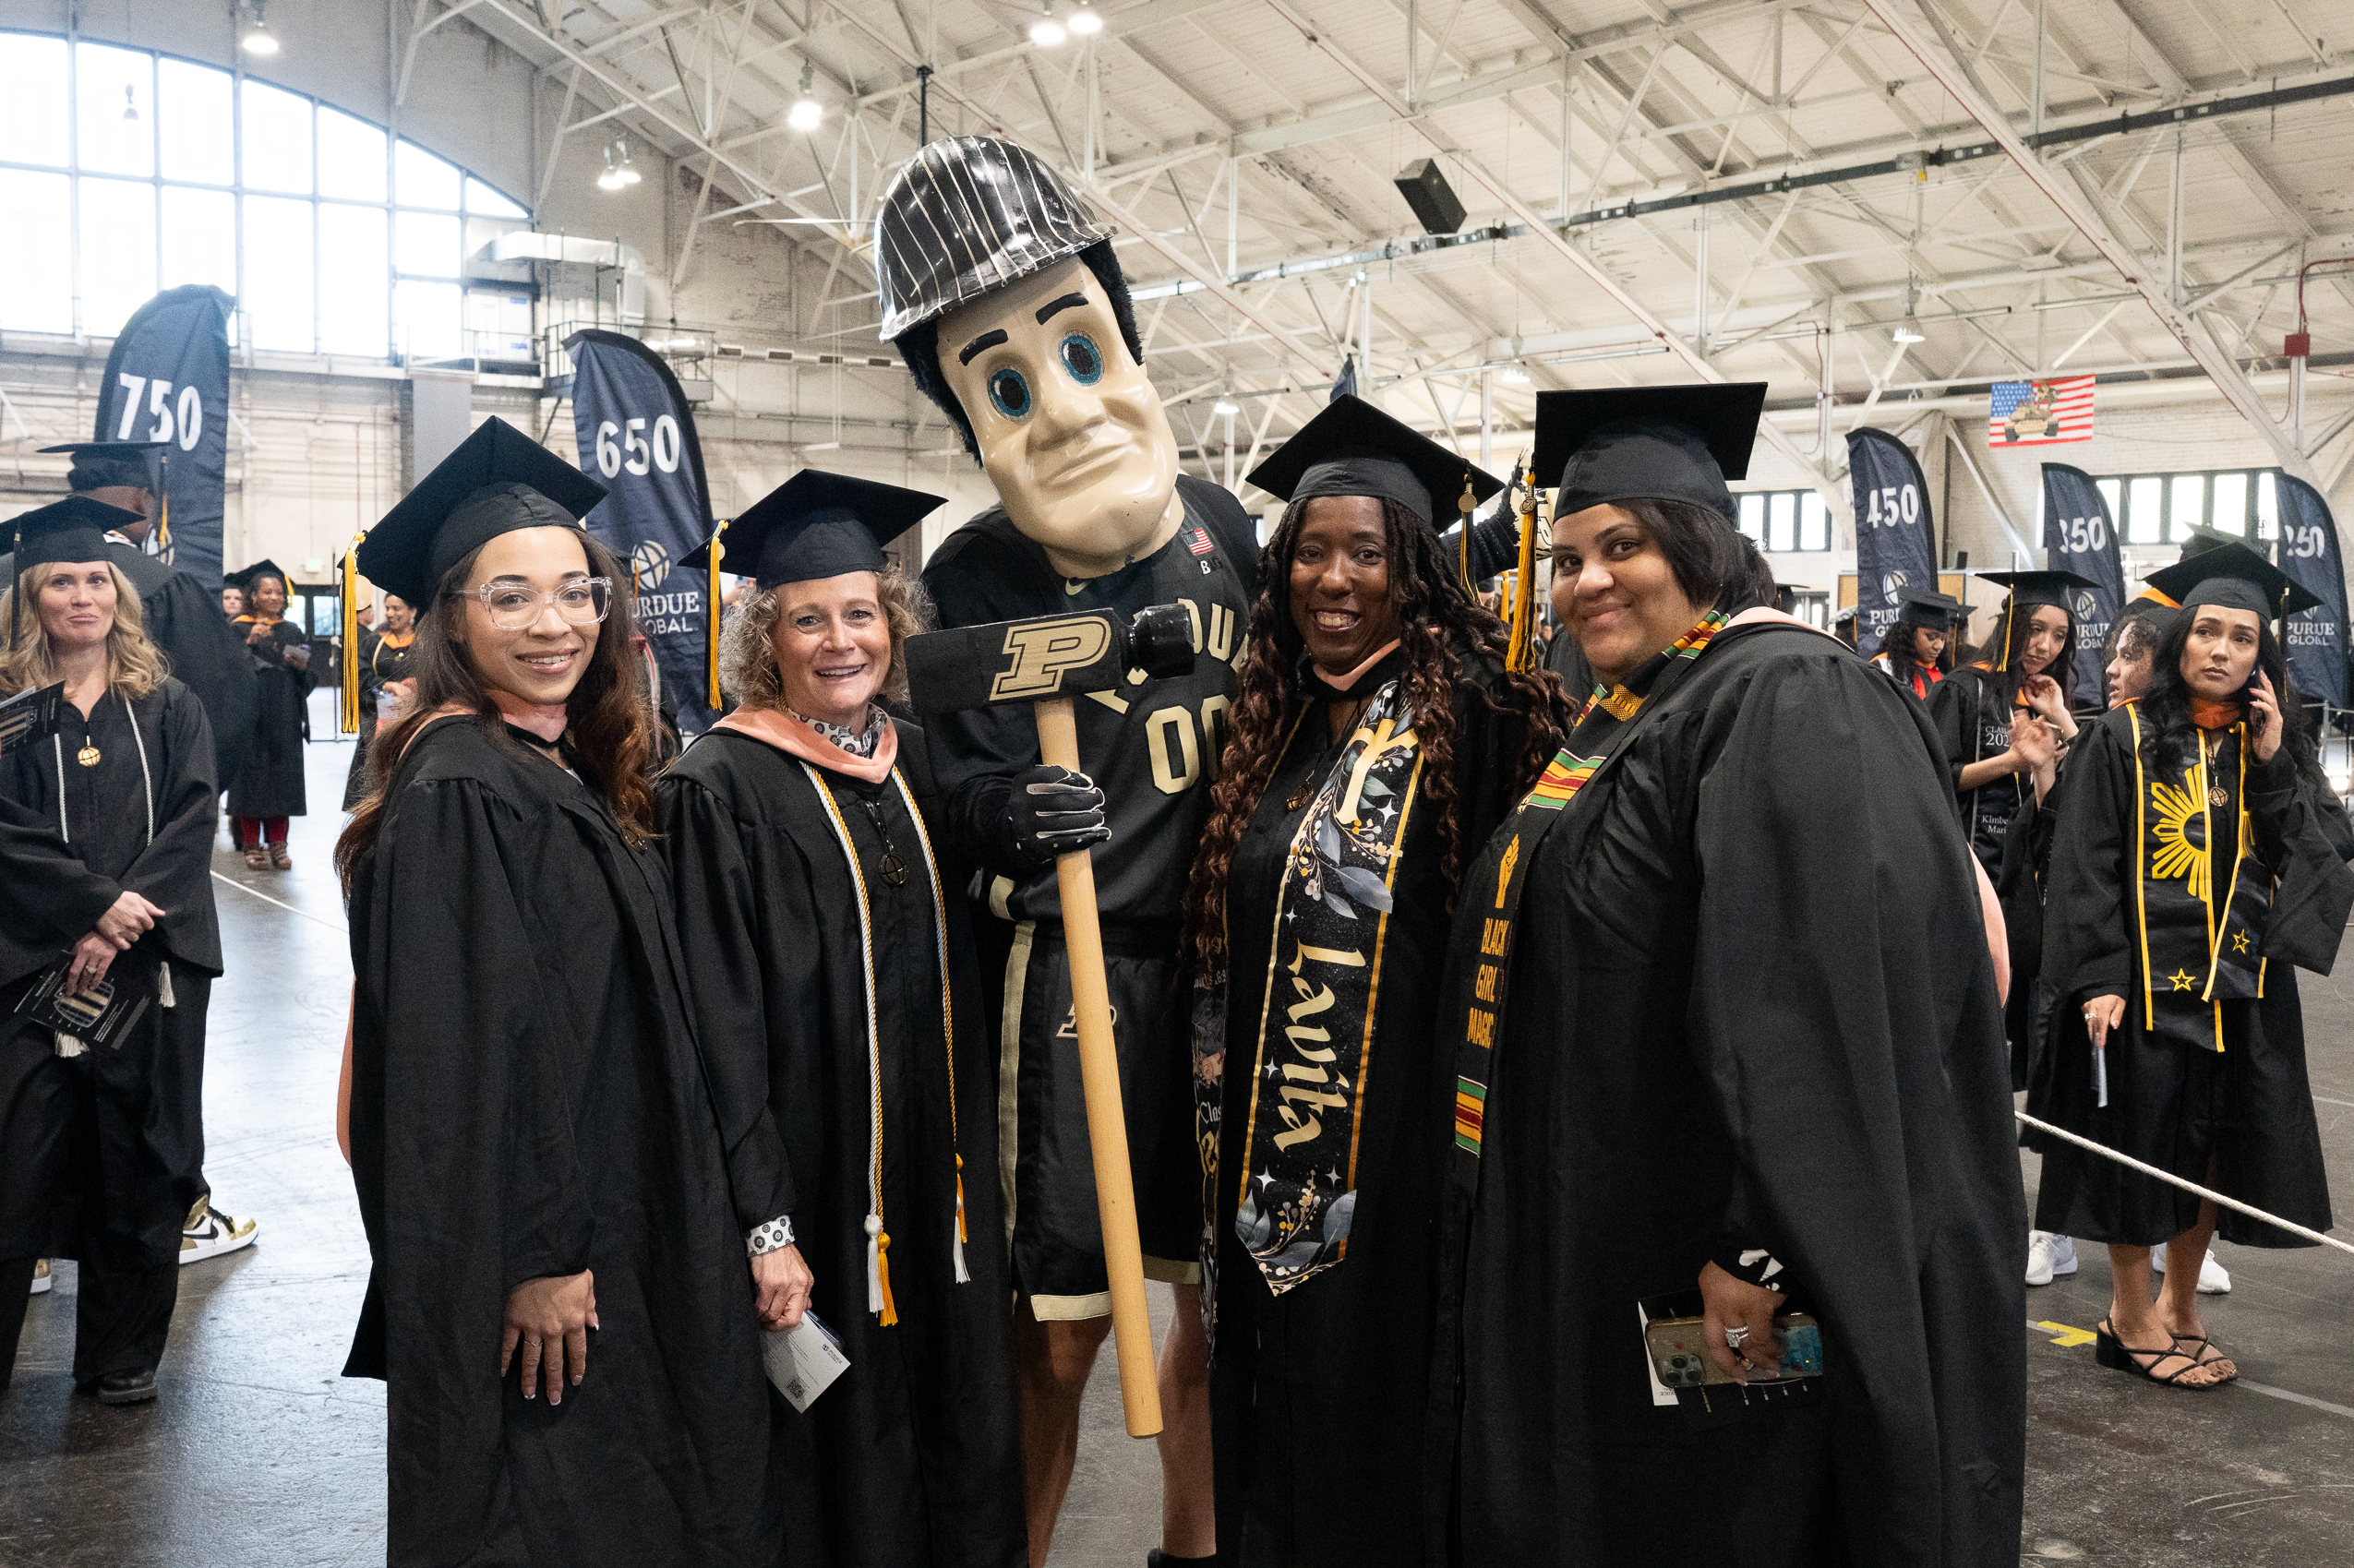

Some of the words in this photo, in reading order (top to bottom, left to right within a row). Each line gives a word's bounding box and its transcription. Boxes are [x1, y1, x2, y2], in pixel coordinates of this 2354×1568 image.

[117, 373, 202, 450] 750
[596, 414, 679, 478] 650
[1867, 484, 1918, 528] 450
[630, 592, 700, 618] URDUE
[1869, 608, 1900, 625] PUR
[645, 616, 693, 634] OBAL
[990, 616, 1111, 700] P
[1986, 733, 2010, 748] 202
[1481, 917, 1509, 956] BLACK
[1475, 964, 1497, 1002] GIRL
[1273, 938, 1365, 1153] Lavita
[1467, 1007, 1494, 1048] MAGIC
[1200, 1101, 1221, 1124] Clas
